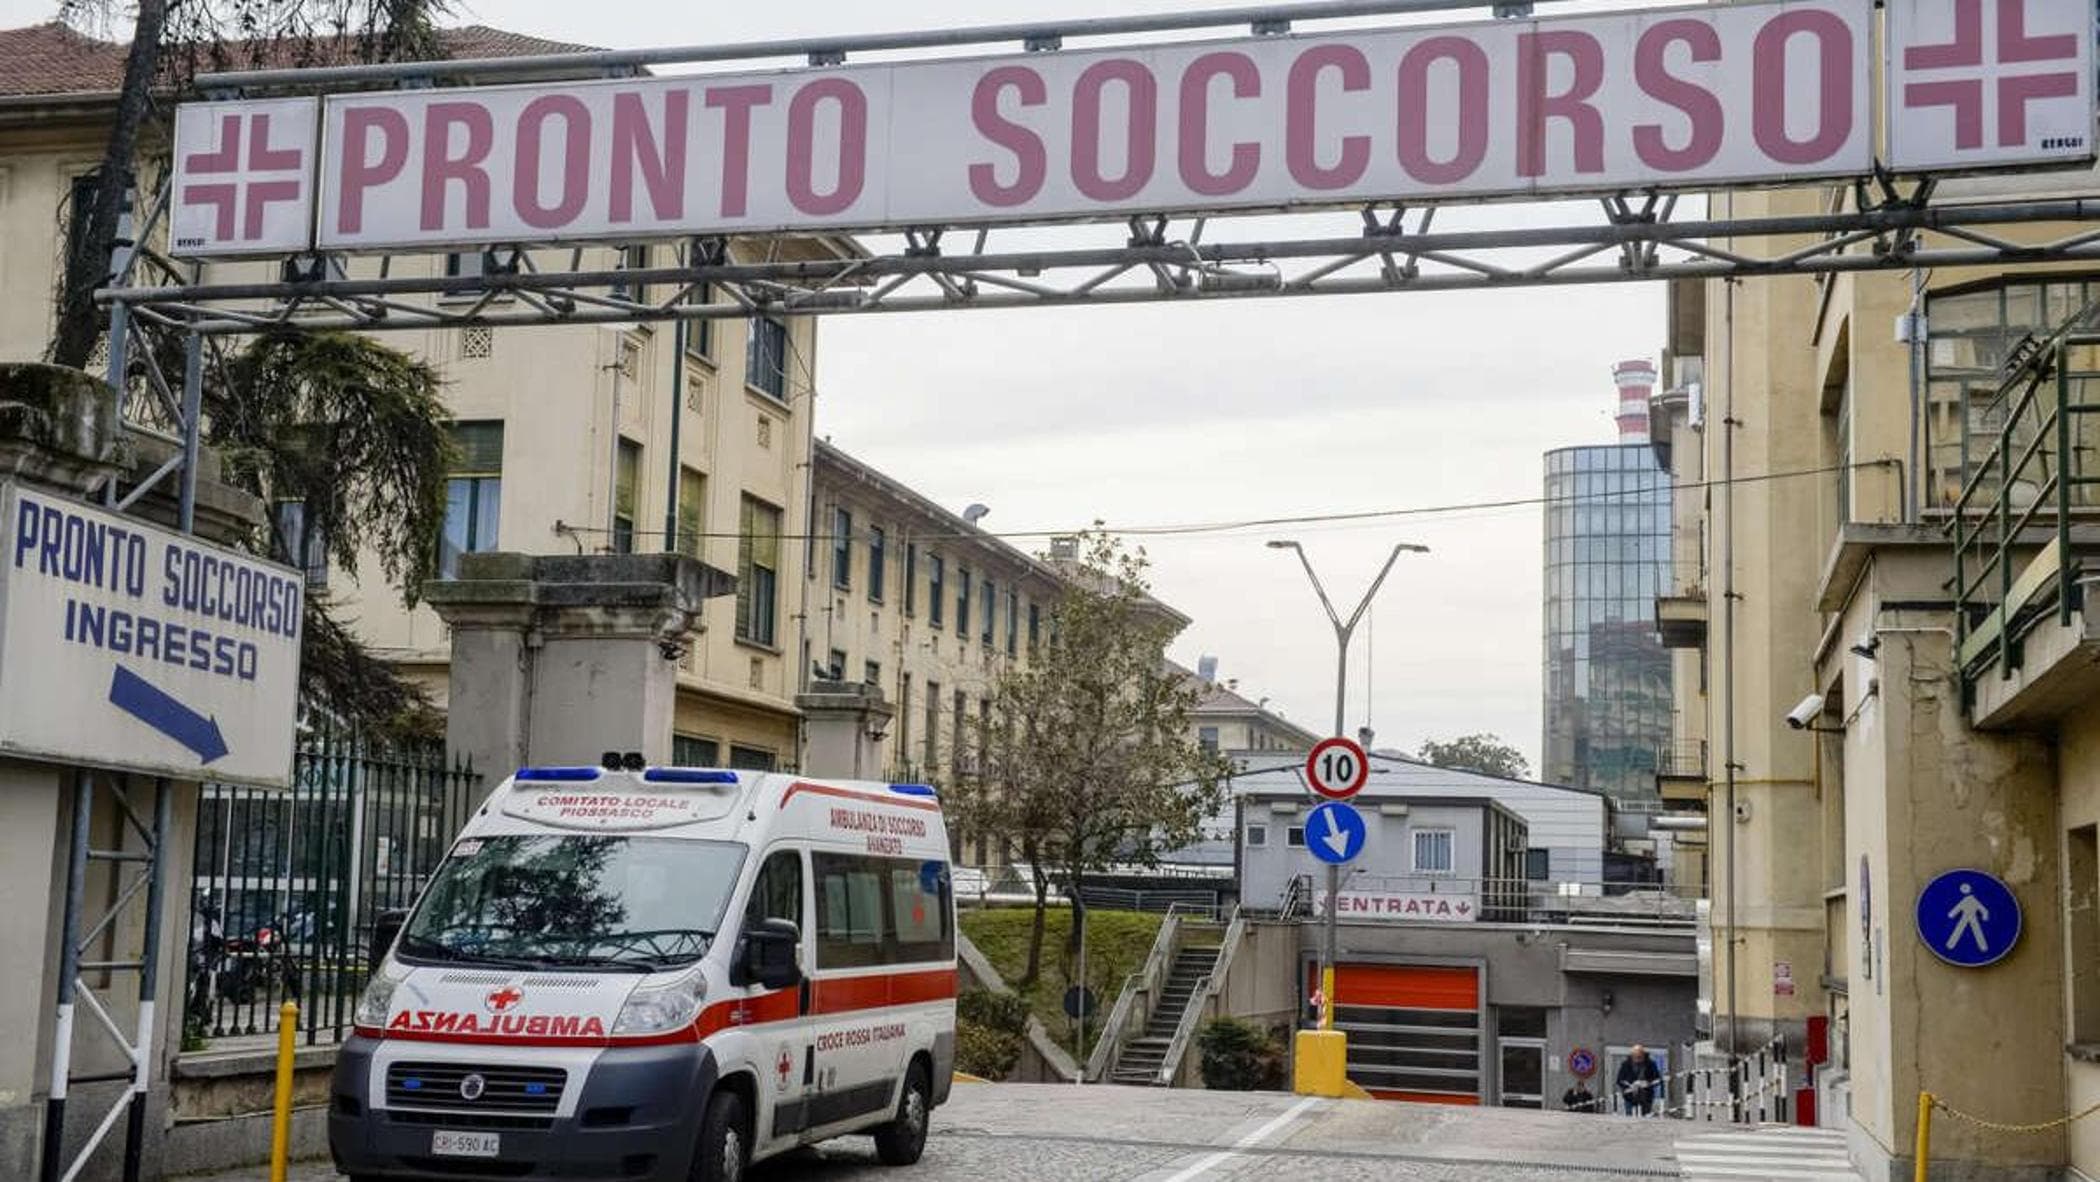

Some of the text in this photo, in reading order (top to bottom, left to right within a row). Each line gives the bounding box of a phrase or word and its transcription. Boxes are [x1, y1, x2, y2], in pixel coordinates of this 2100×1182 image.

[337, 9, 1854, 235] PRONTO SOCCORSO
[14, 498, 299, 639] PRONTO SOCCORSO
[64, 599, 258, 682] INGRESSO
[1322, 754, 1354, 783] 10
[537, 795, 690, 810] COMITATO LOCALE
[559, 806, 655, 819] PIOSSASCO
[830, 807, 926, 837] AMBULANZA DI SOCCORSO
[1337, 896, 1452, 916] ENTRATA
[816, 1023, 906, 1052] CROCE ROSSA ITALIANA
[482, 1136, 499, 1153] AC
